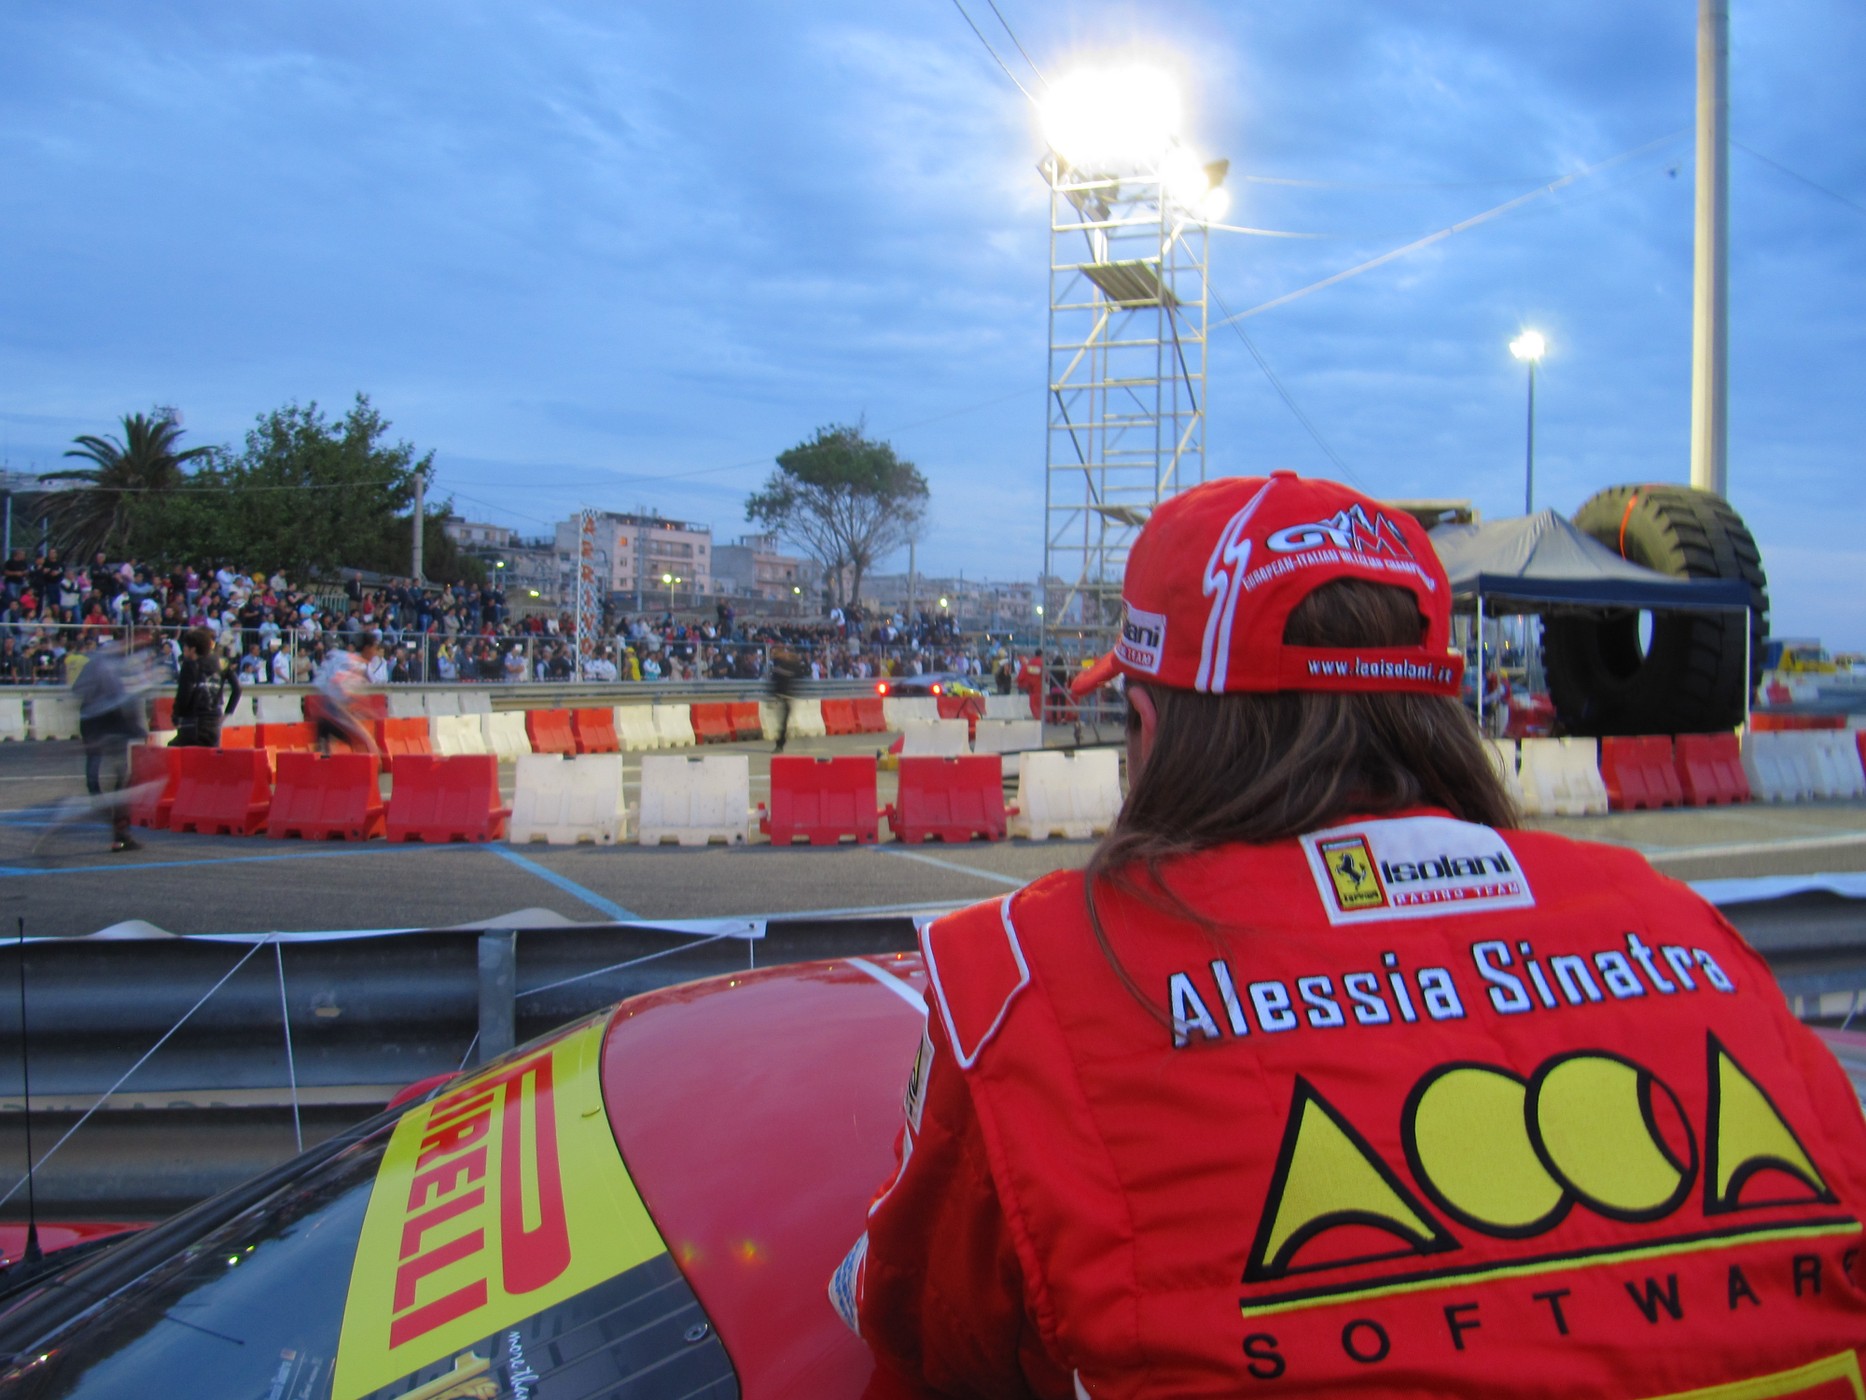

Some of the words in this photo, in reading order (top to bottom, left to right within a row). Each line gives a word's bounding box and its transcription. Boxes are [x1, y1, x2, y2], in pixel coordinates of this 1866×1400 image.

[581, 516, 596, 655] ARRIVO
[1396, 888, 1464, 905] RACING
[1474, 881, 1520, 899] TEAM
[1169, 953, 1466, 1048] Alessia
[1471, 932, 1738, 1027] Sinatra
[388, 1050, 572, 1350] PIRELLI
